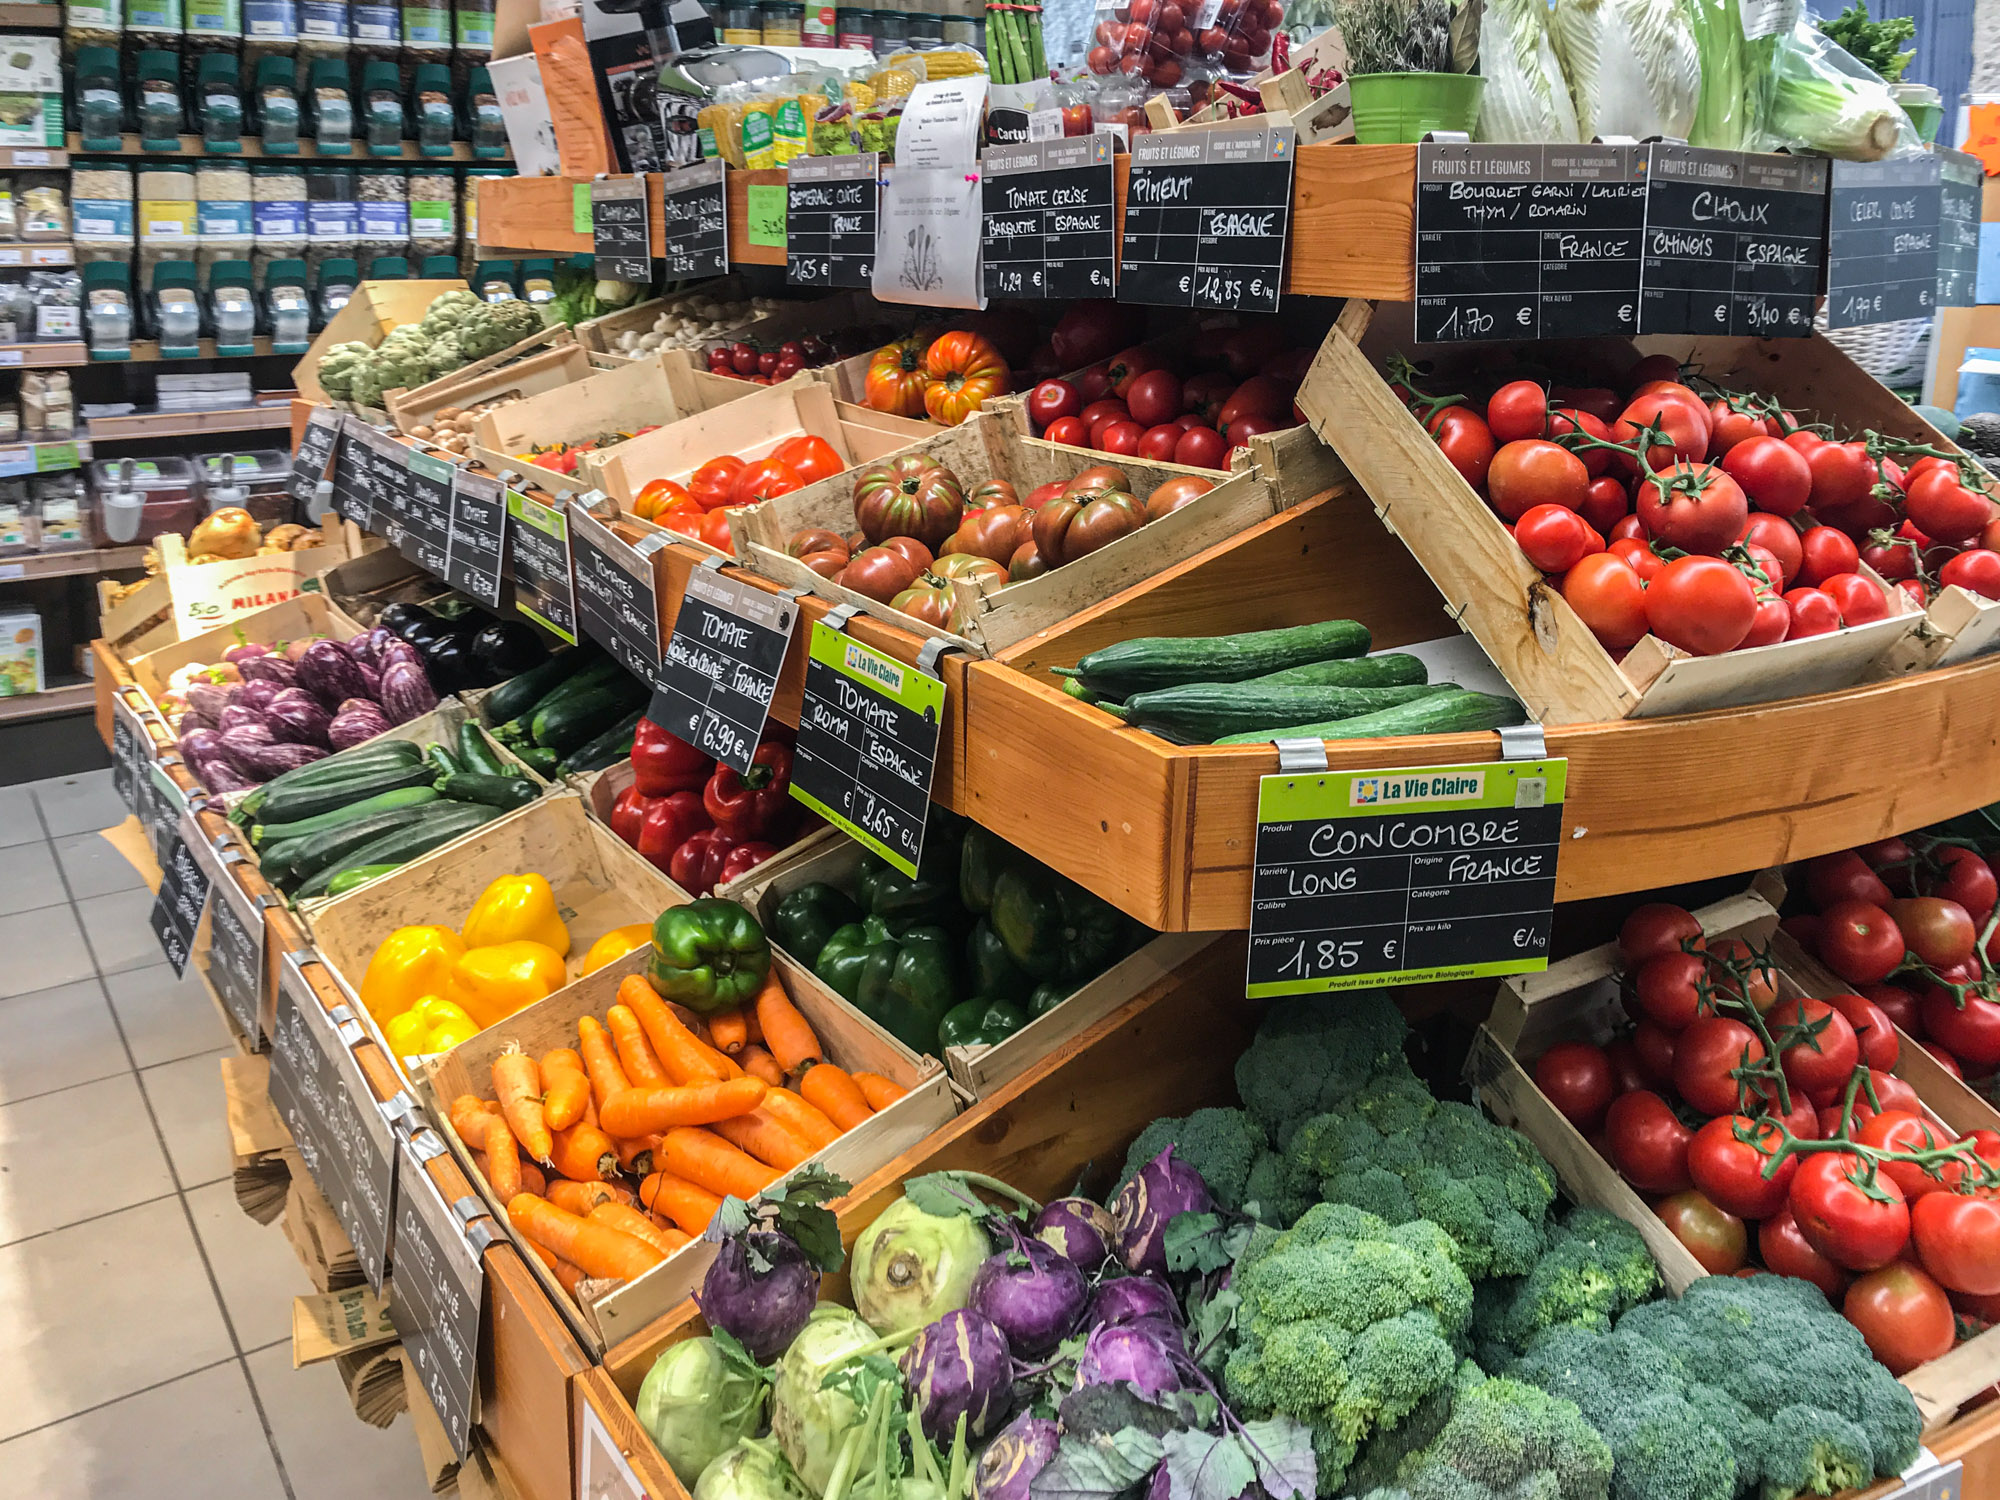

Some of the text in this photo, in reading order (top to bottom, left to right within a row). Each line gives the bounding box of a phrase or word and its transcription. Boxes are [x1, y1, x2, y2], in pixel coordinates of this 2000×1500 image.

[1138, 148, 1159, 160] FRUITS
[1161, 147, 1168, 159] ET
[1569, 159, 1577, 167] DE
[1432, 160, 1467, 174] FRUITS
[1470, 160, 1481, 174] ET
[1660, 159, 1686, 174] FRUITS
[1688, 162, 1697, 174] ET
[1006, 187, 1048, 209] TOMATE
[1423, 184, 1443, 192] PRODUIT
[1449, 181, 1527, 200] BOUQUET
[1692, 191, 1770, 225] CHOUX
[1055, 215, 1101, 231] ESPAGNE
[1560, 235, 1629, 259] FRANCE
[1746, 243, 1809, 266] ESPAGNE
[821, 263, 828, 275] €
[1033, 272, 1042, 286] €
[1179, 276, 1190, 292] €
[1714, 305, 1726, 322] €
[1874, 296, 1882, 311] €
[1437, 306, 1532, 339] 1,70 €
[590, 550, 634, 599] TOMATES
[701, 611, 753, 649] TOMATE
[610, 637, 618, 650] €
[858, 653, 900, 687] La Vie Claire
[732, 663, 773, 703] FRANCE
[834, 678, 898, 737] TOMATE
[689, 714, 699, 731] €
[813, 703, 849, 742] ROMA
[703, 718, 736, 757] 6,99
[870, 739, 923, 786] ESPAGNE
[1383, 777, 1478, 800] La Vie Claire
[844, 791, 851, 808] €
[1262, 824, 1292, 833] Produit
[1309, 819, 1519, 857] CONCOMBRE
[901, 828, 918, 855] €/kg
[1414, 856, 1443, 866] Origine
[1448, 854, 1542, 884] FRANCE
[1259, 867, 1288, 877] Variété
[1288, 867, 1357, 896] LONG
[1411, 888, 1450, 898] Catégorie
[1257, 901, 1286, 910] Calibre
[1408, 922, 1452, 933] Prix au kilo
[1254, 935, 1295, 947] Prix pièce
[1512, 928, 1546, 948] €/kg
[1277, 939, 1397, 979] 1,85 €
[1328, 980, 1356, 989] Produit
[1358, 978, 1374, 987] issu
[1376, 977, 1386, 985] de
[1435, 968, 1475, 981] Biologique
[439, 1310, 463, 1369] FRANCE
[419, 1348, 426, 1369] €
